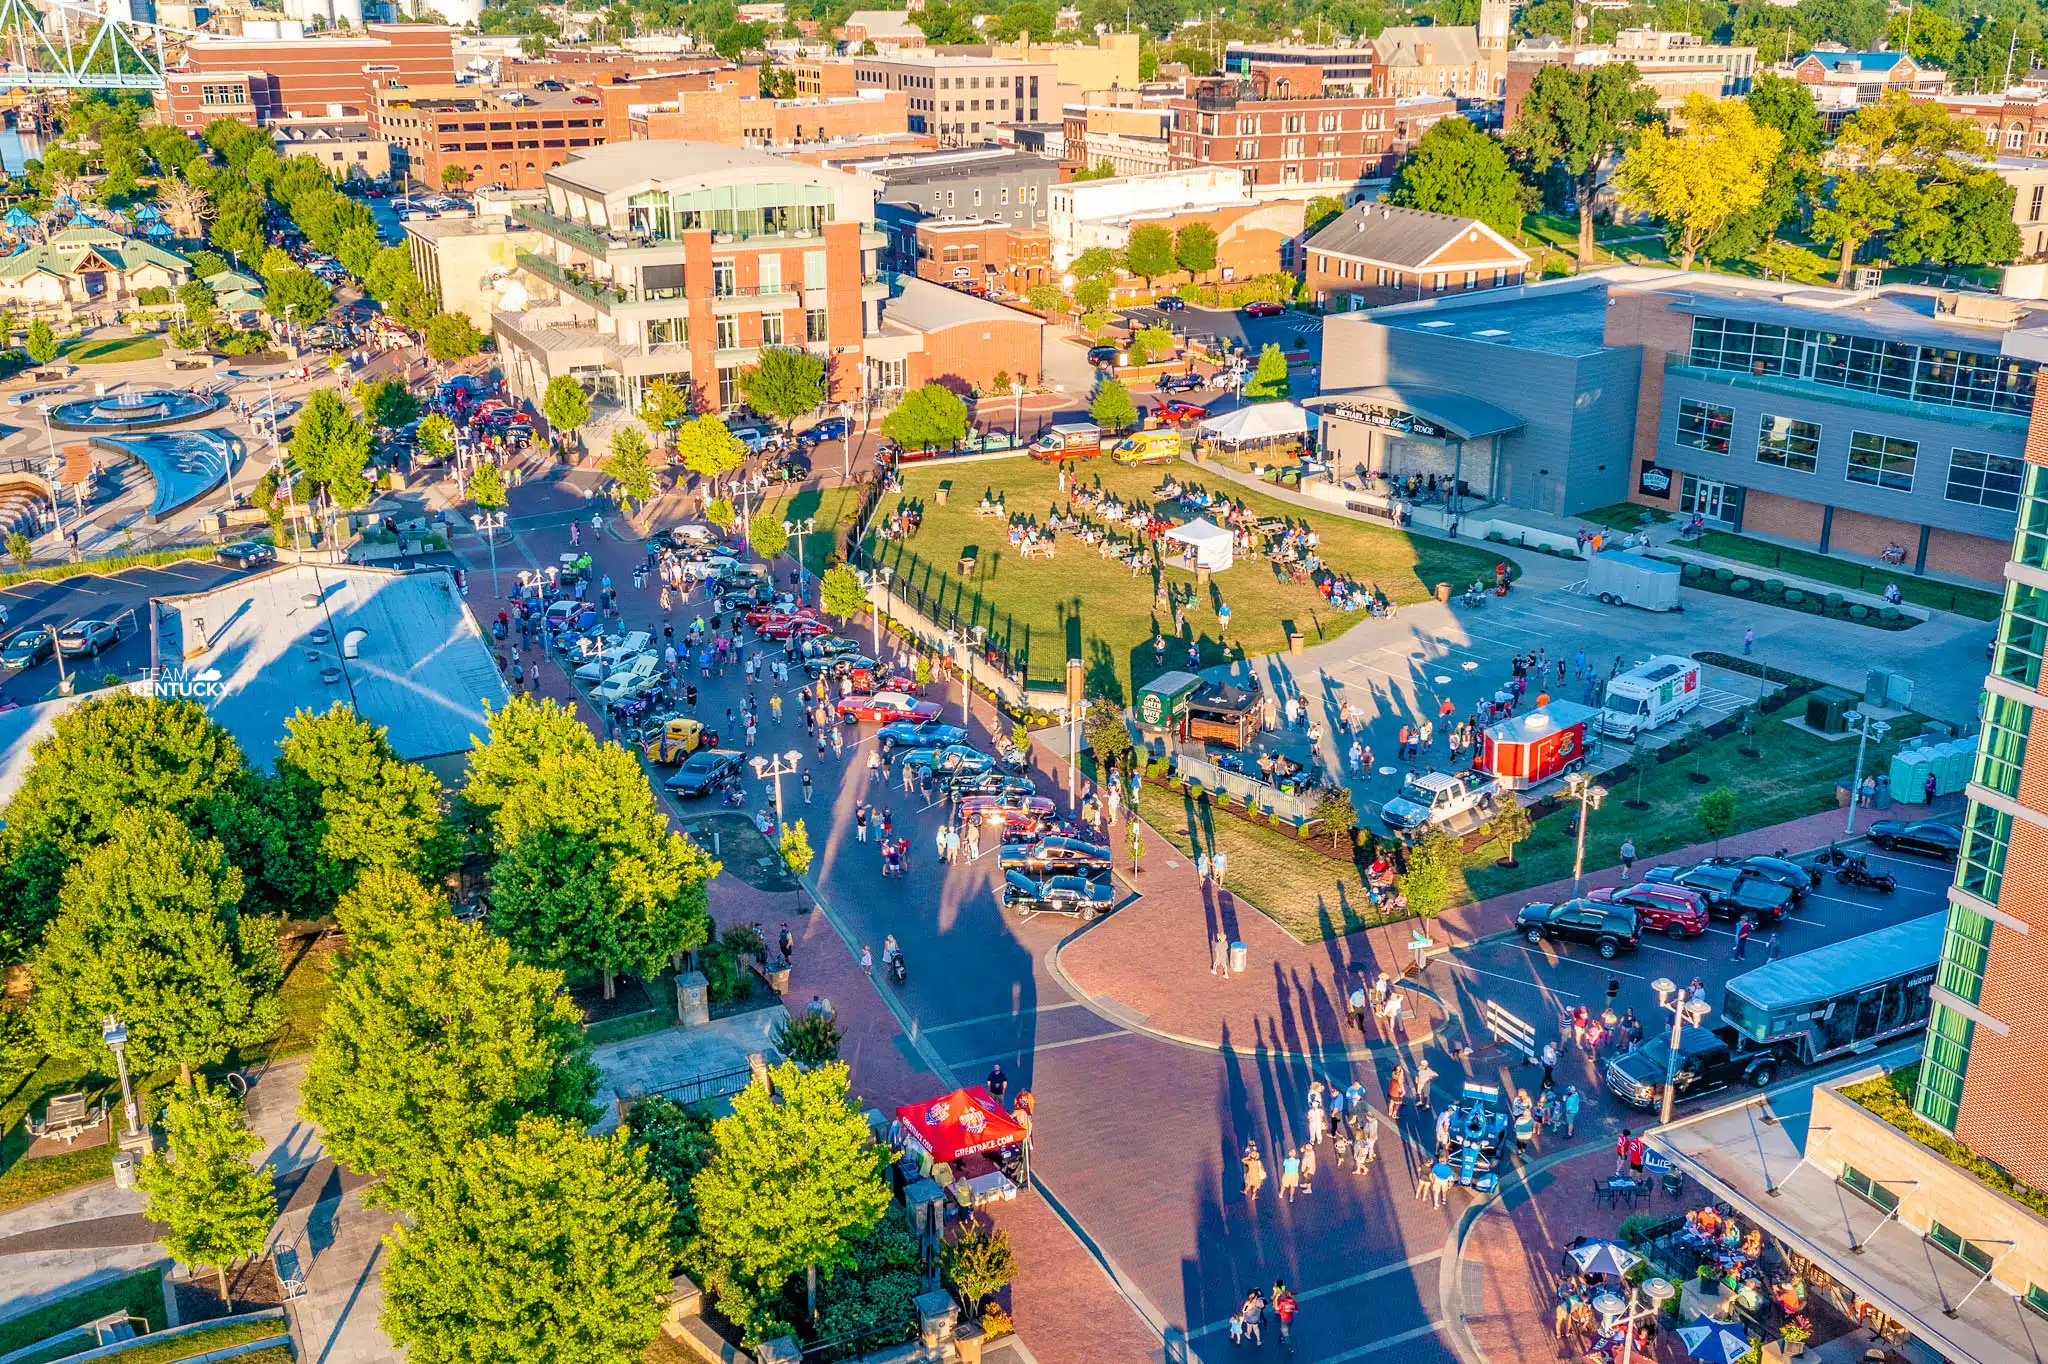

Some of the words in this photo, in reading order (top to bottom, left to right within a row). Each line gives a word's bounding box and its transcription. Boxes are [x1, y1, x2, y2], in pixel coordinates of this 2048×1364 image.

[1335, 408, 1364, 421] MICHAEL
[1372, 416, 1390, 426] HORN
[1413, 424, 1434, 435] STAGE
[1143, 699, 1161, 709] GREEN
[1143, 708, 1160, 718] RIVER
[1907, 973, 1934, 987] HAGERTY
[902, 1116, 934, 1153] GREATRACE.COM
[954, 1135, 1014, 1158] GREATRACE.COM
[1645, 1151, 1671, 1169] Lure
